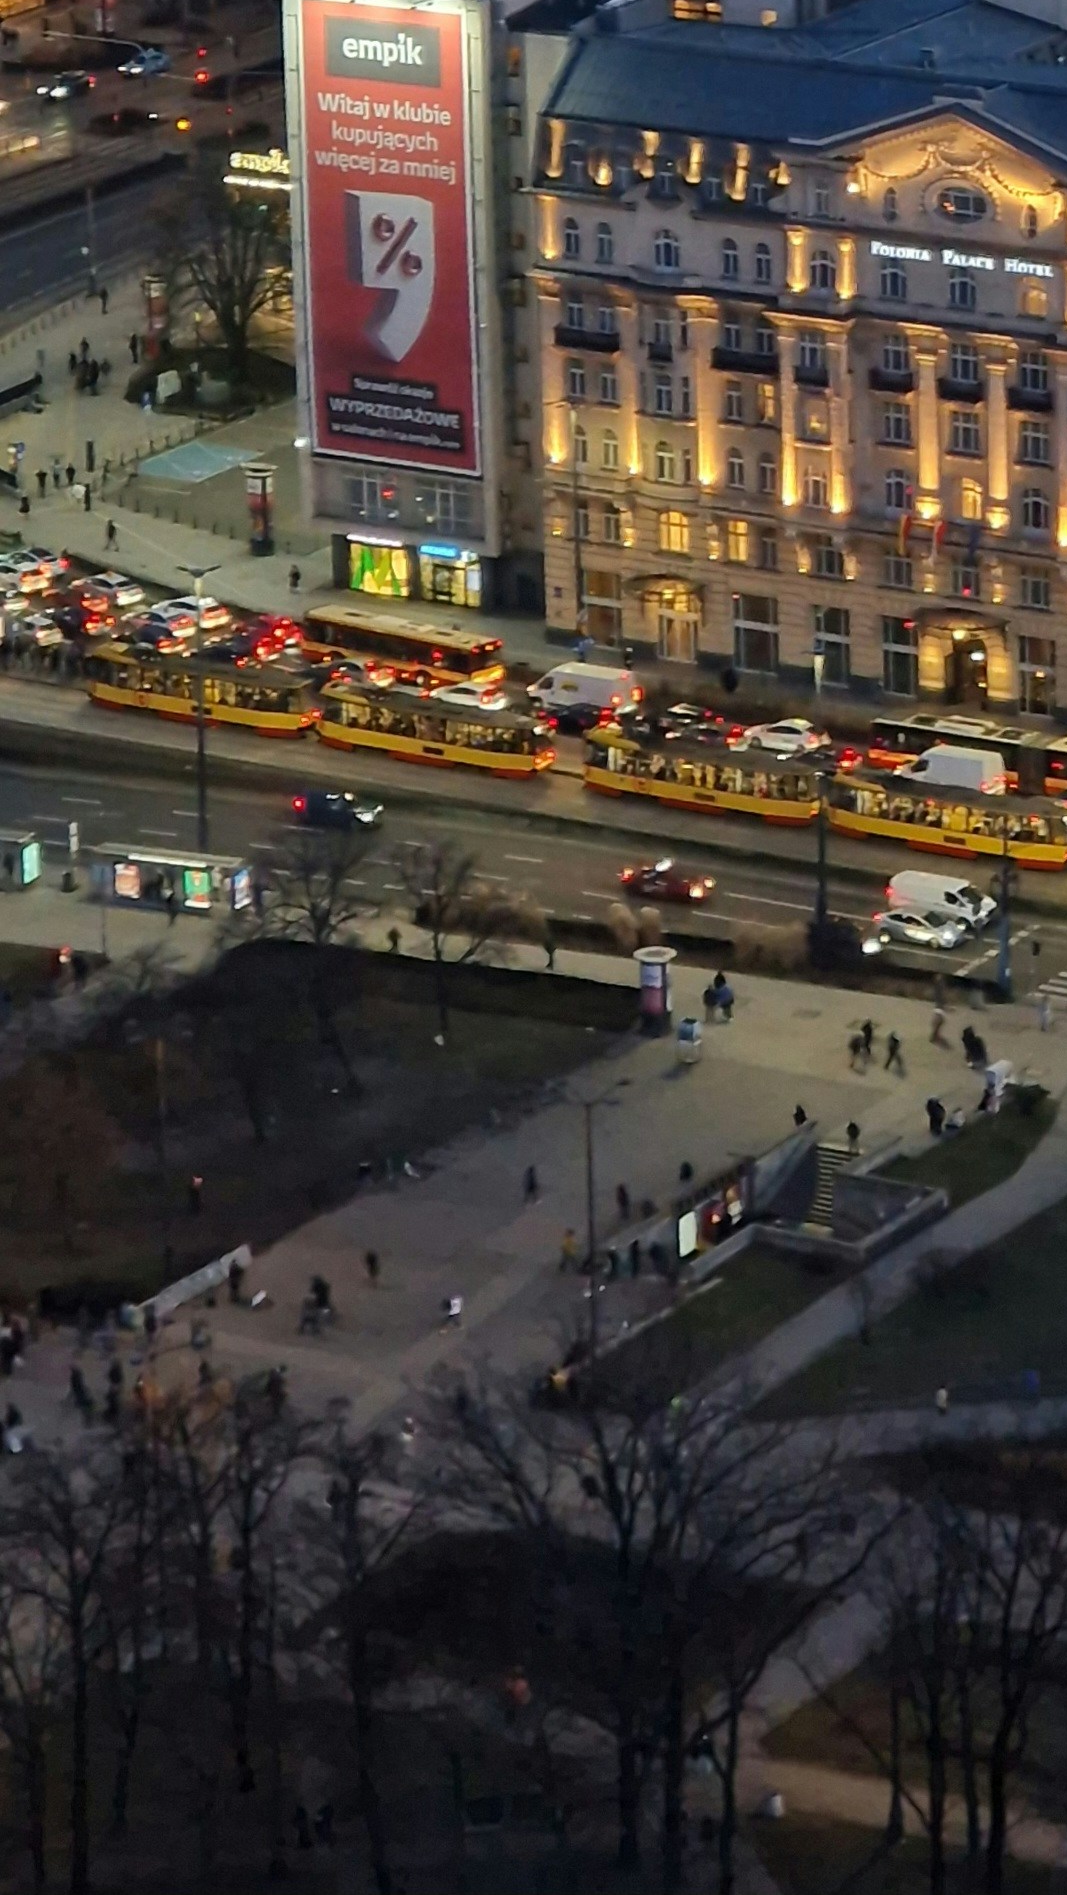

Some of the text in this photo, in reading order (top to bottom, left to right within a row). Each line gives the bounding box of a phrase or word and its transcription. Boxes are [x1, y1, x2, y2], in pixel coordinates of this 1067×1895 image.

[342, 33, 423, 67] empik
[317, 92, 451, 126] Witaj w klubie
[331, 119, 438, 153] kupujących
[314, 146, 456, 185] więcej za mniej
[329, 396, 460, 430] WYPRZEDAŻOWE
